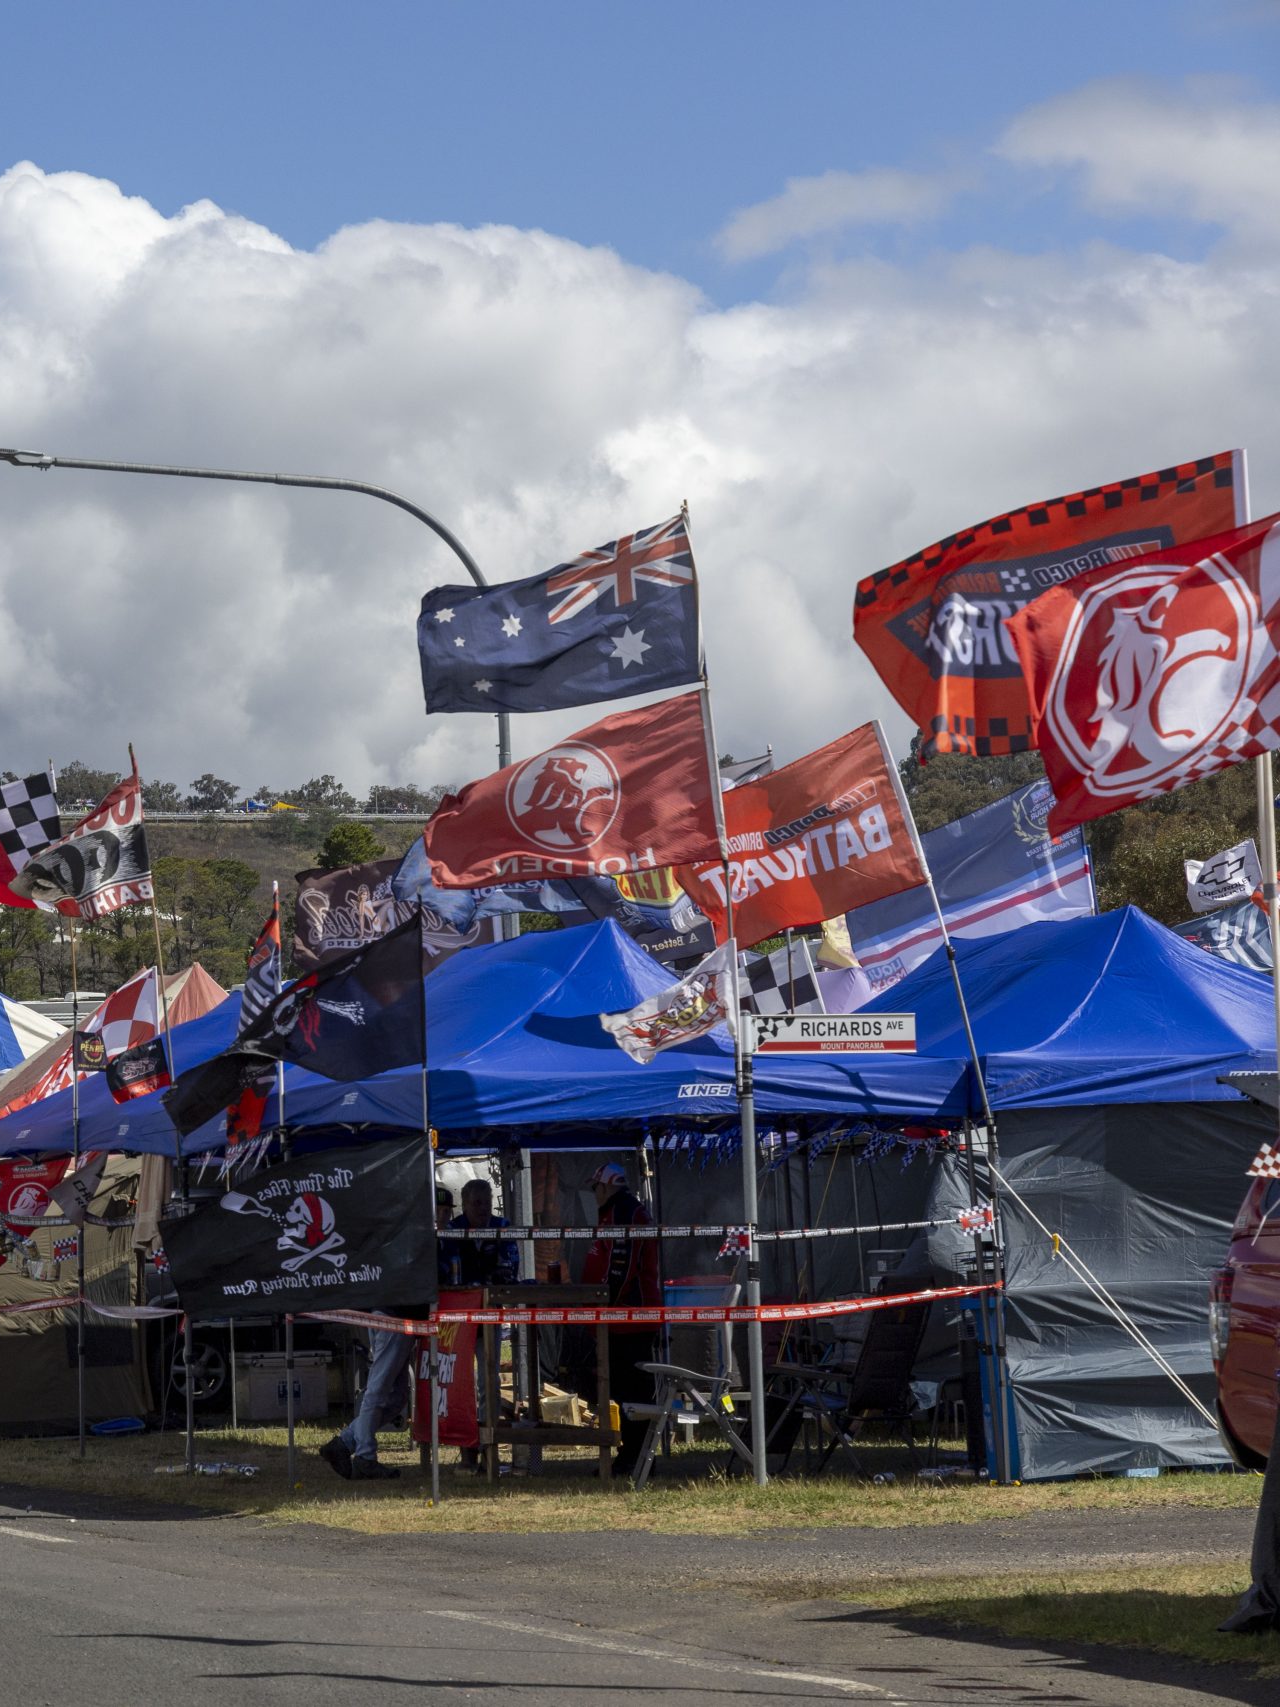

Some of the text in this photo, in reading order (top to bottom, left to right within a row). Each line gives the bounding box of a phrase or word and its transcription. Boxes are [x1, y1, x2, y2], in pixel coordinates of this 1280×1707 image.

[1198, 875, 1252, 898] CHEVROLET
[800, 1020, 904, 1038] RICHARDS AVE
[820, 1041, 885, 1050] MOUNT PANORAMA
[679, 1084, 732, 1098] KINGS
